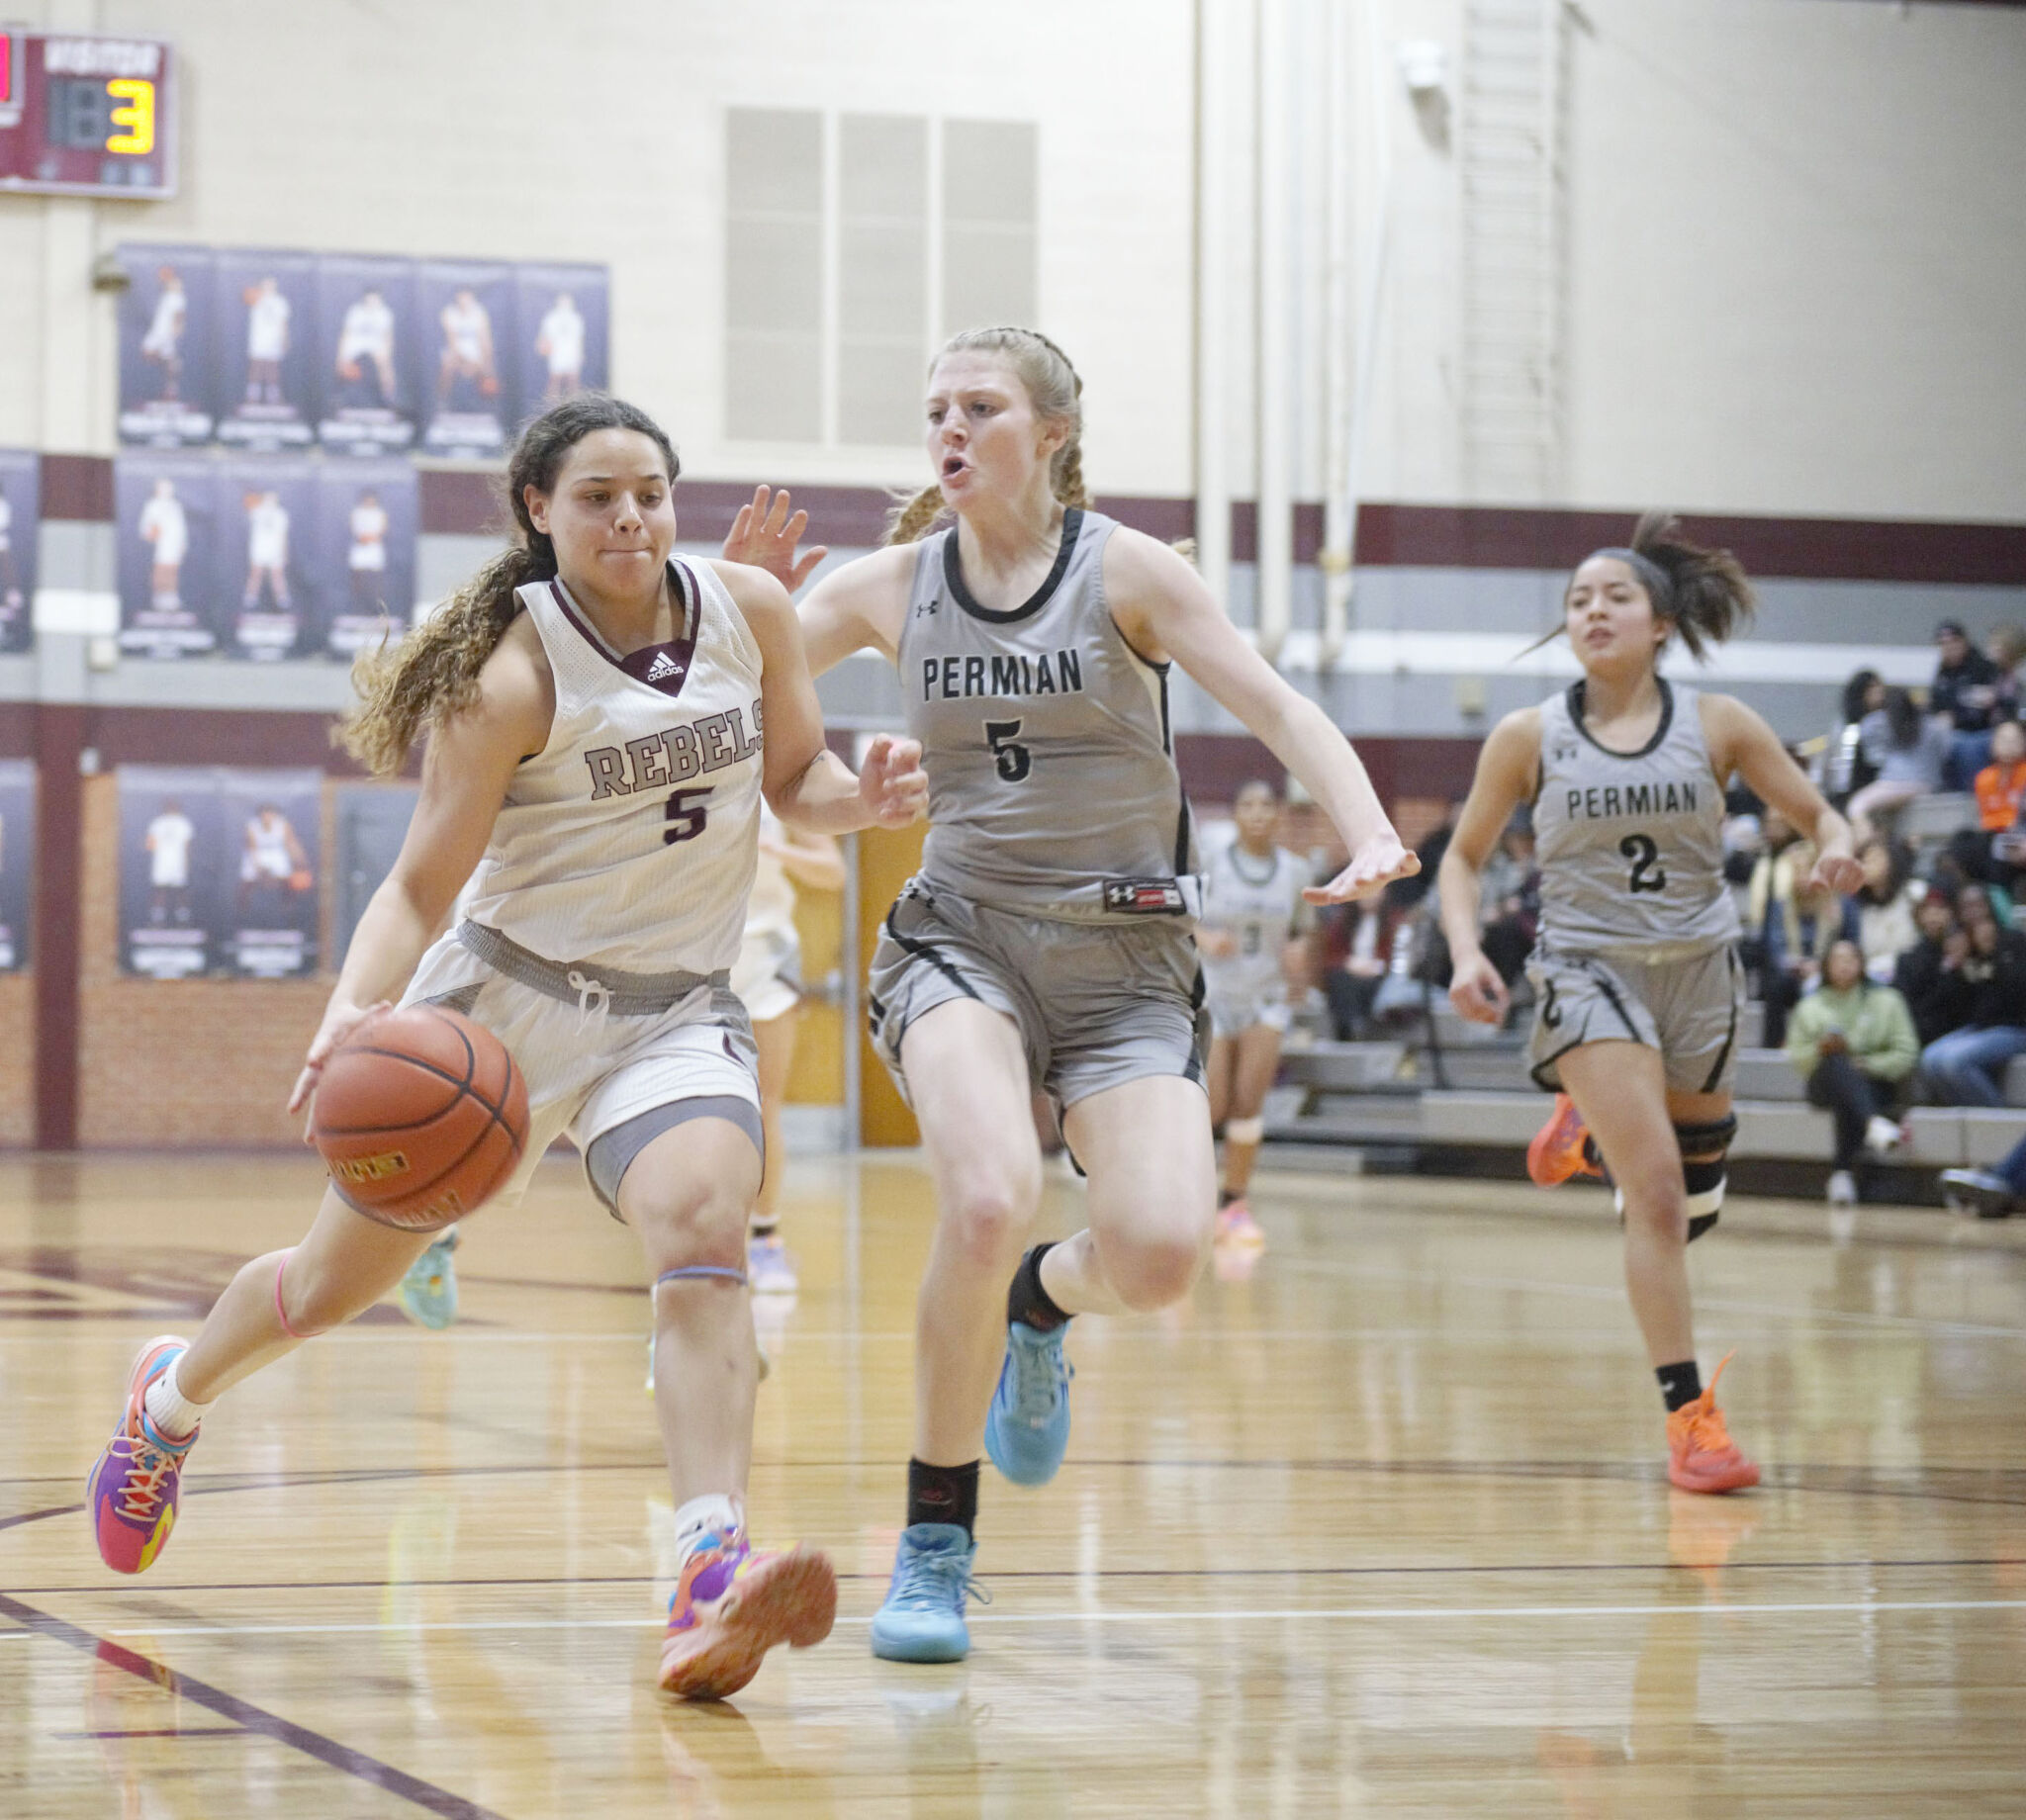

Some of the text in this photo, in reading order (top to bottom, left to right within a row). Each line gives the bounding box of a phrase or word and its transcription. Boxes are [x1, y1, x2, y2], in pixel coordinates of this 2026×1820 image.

[106, 78, 155, 154] 3
[647, 666, 685, 682] adidas
[923, 649, 1082, 701] PERMIAN
[983, 717, 1032, 784] 5
[663, 785, 716, 846] 5
[1566, 782, 1698, 819] PERMIAN
[1618, 834, 1667, 893] 2
